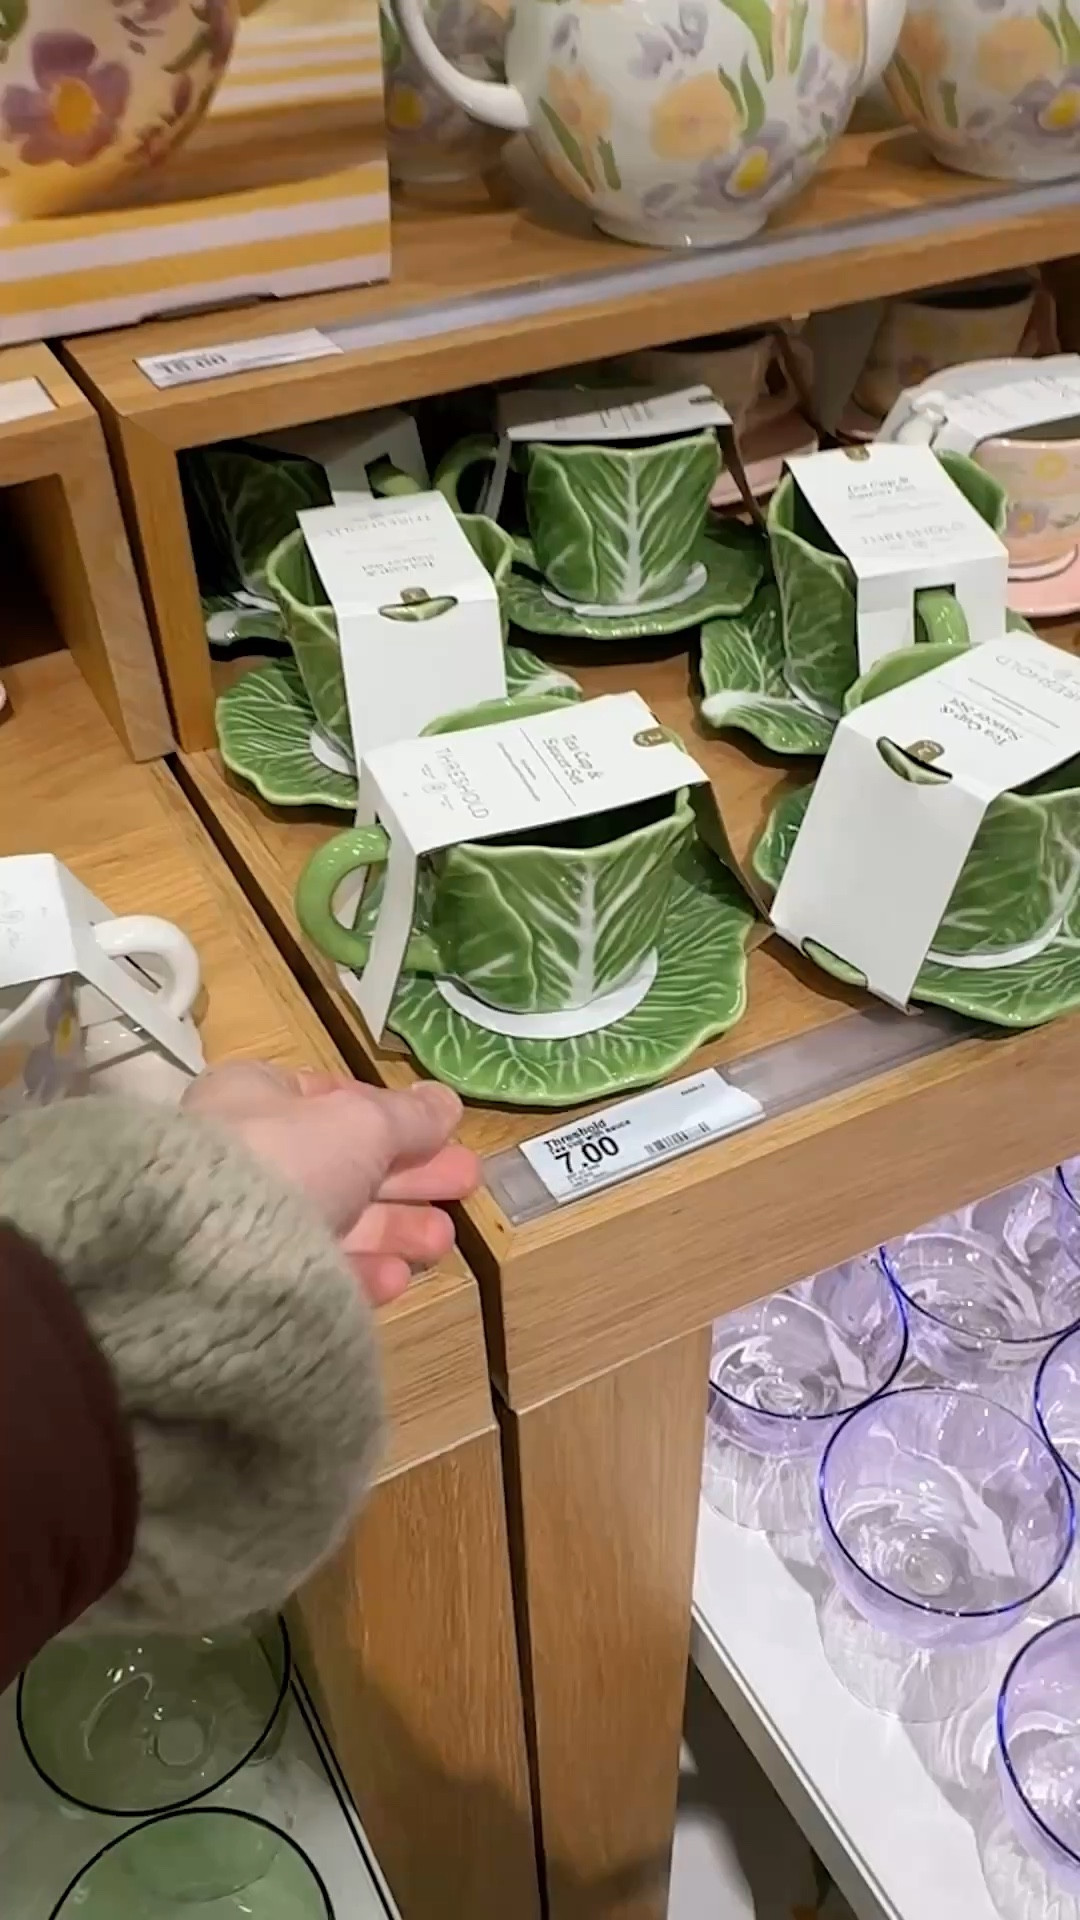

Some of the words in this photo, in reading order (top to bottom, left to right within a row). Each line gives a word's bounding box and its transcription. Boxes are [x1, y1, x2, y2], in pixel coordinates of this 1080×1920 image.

[572, 749, 596, 770] Cup
[435, 745, 490, 820] THRESHOLD
[544, 1118, 607, 1150] Threshold
[555, 1136, 620, 1173] 7.00
